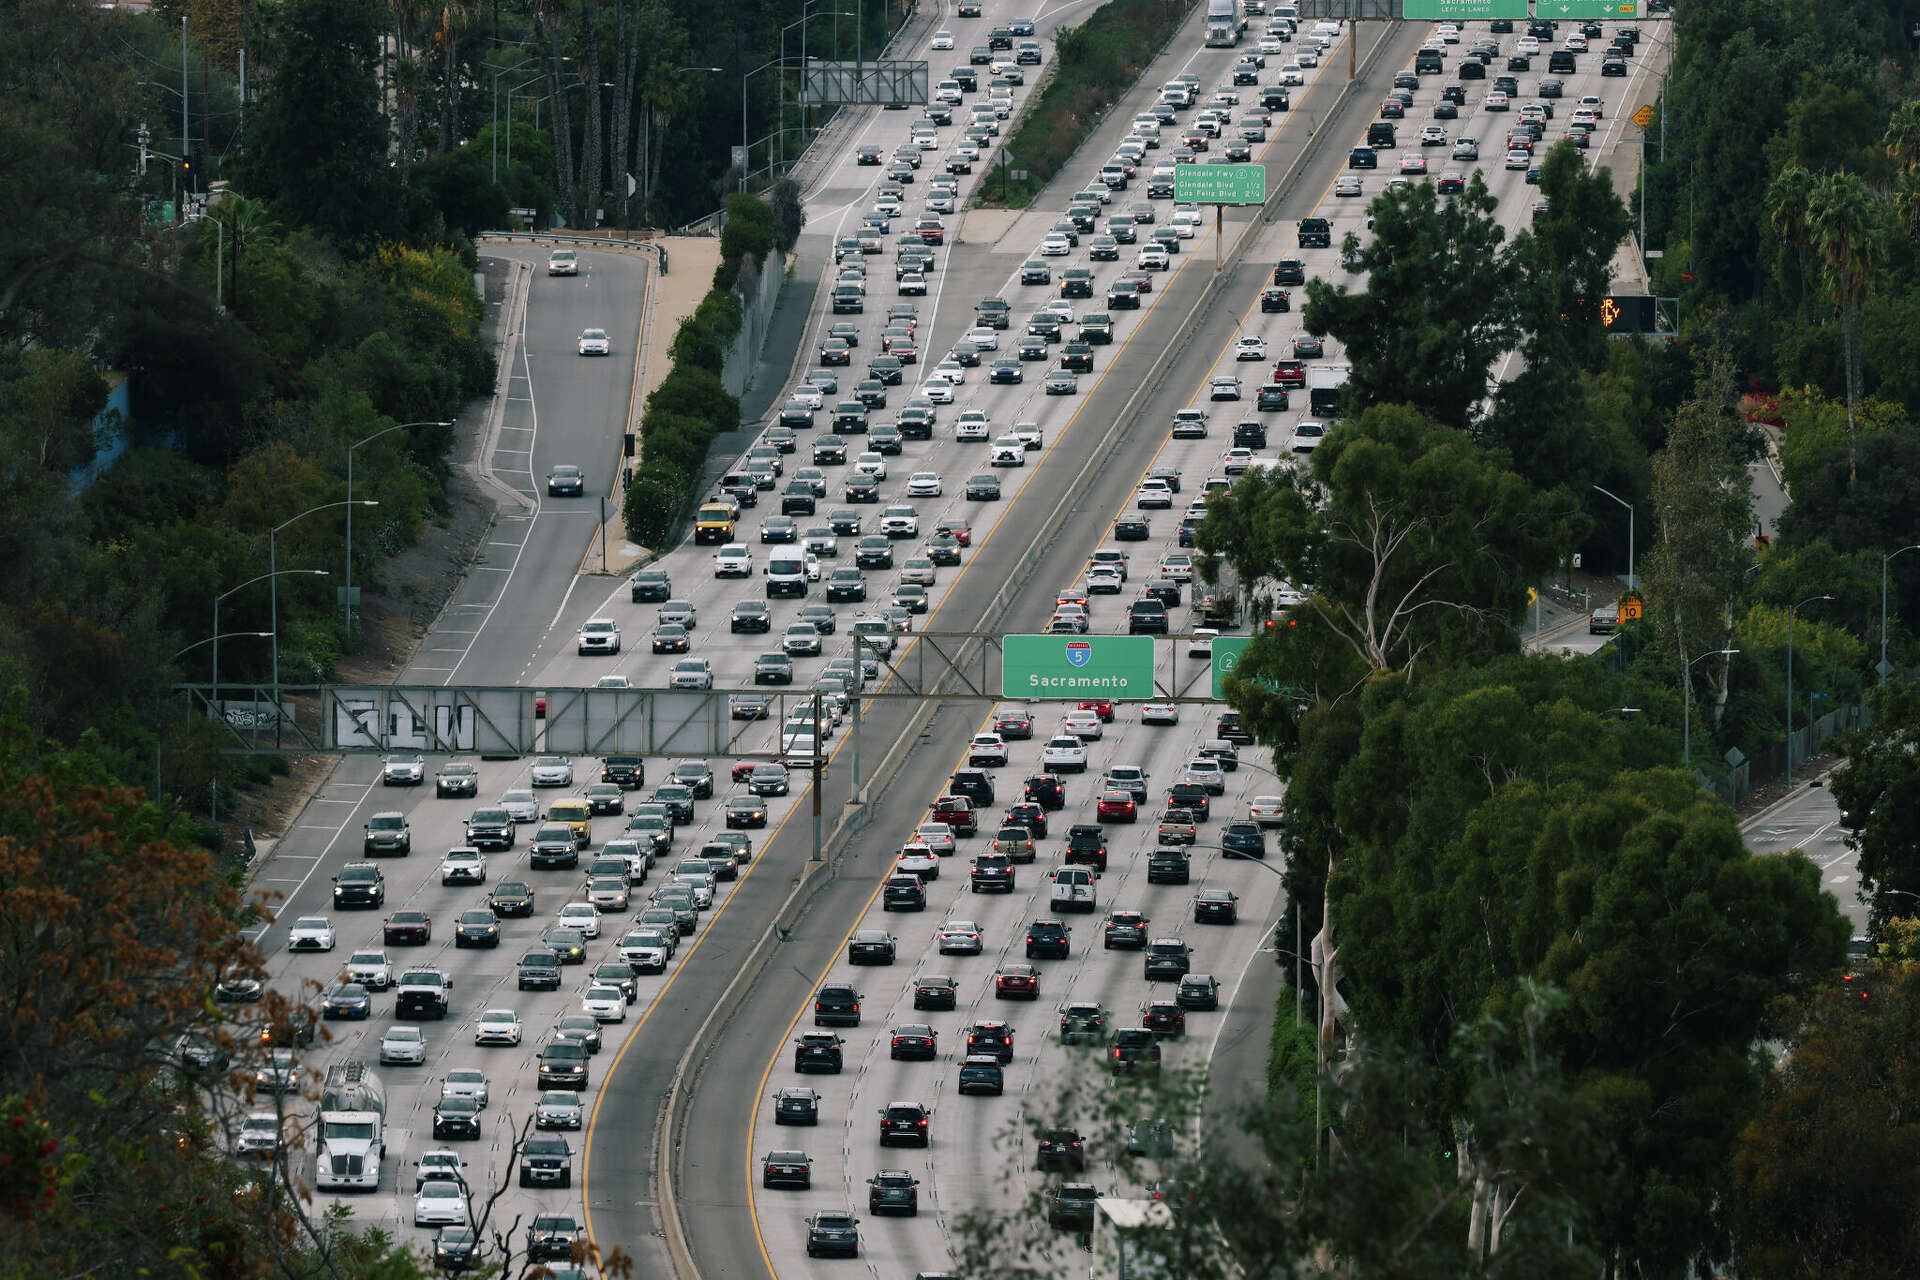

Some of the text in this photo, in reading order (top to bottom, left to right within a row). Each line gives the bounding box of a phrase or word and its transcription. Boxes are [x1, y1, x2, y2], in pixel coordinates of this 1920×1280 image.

[1179, 169, 1213, 177] Glendale
[1217, 170, 1234, 178] Fwy
[1625, 608, 1637, 617] 10
[1075, 651, 1082, 662] 5
[1226, 659, 1233, 668] 2
[1029, 674, 1129, 688] Sacramento
